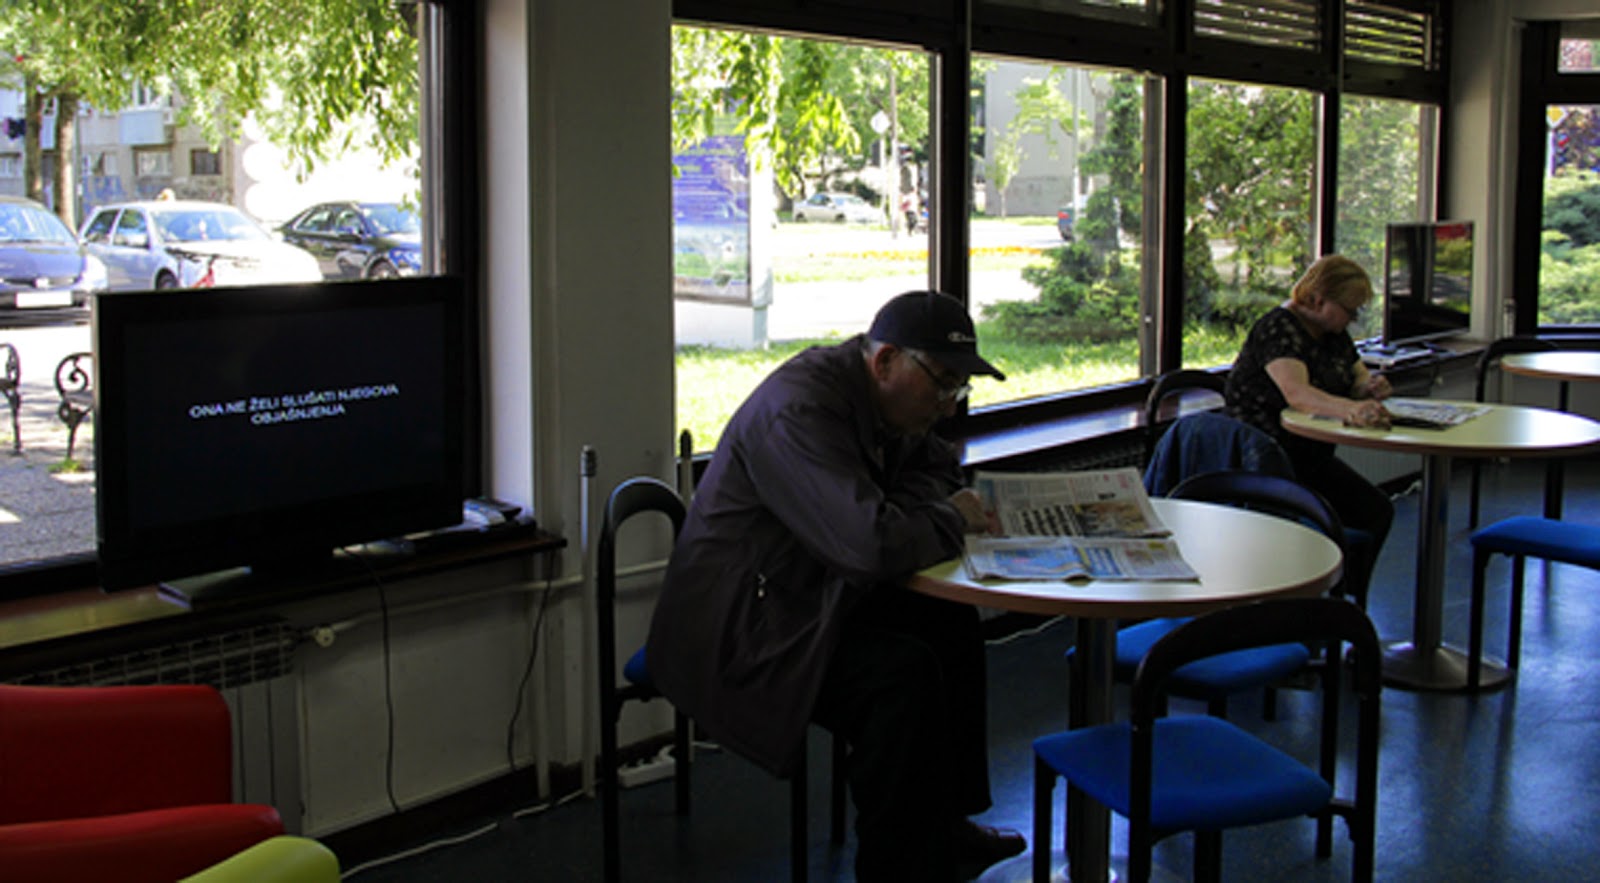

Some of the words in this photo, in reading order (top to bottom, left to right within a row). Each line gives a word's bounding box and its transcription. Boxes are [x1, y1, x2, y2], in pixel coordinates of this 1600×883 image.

[189, 404, 223, 418] ONA
[225, 400, 246, 413] NE
[249, 397, 280, 411] ŽELI
[281, 390, 336, 406] SLUŠATI
[338, 384, 399, 400] NJEGOVA
[251, 404, 345, 424] OBJAŠNJENJA
